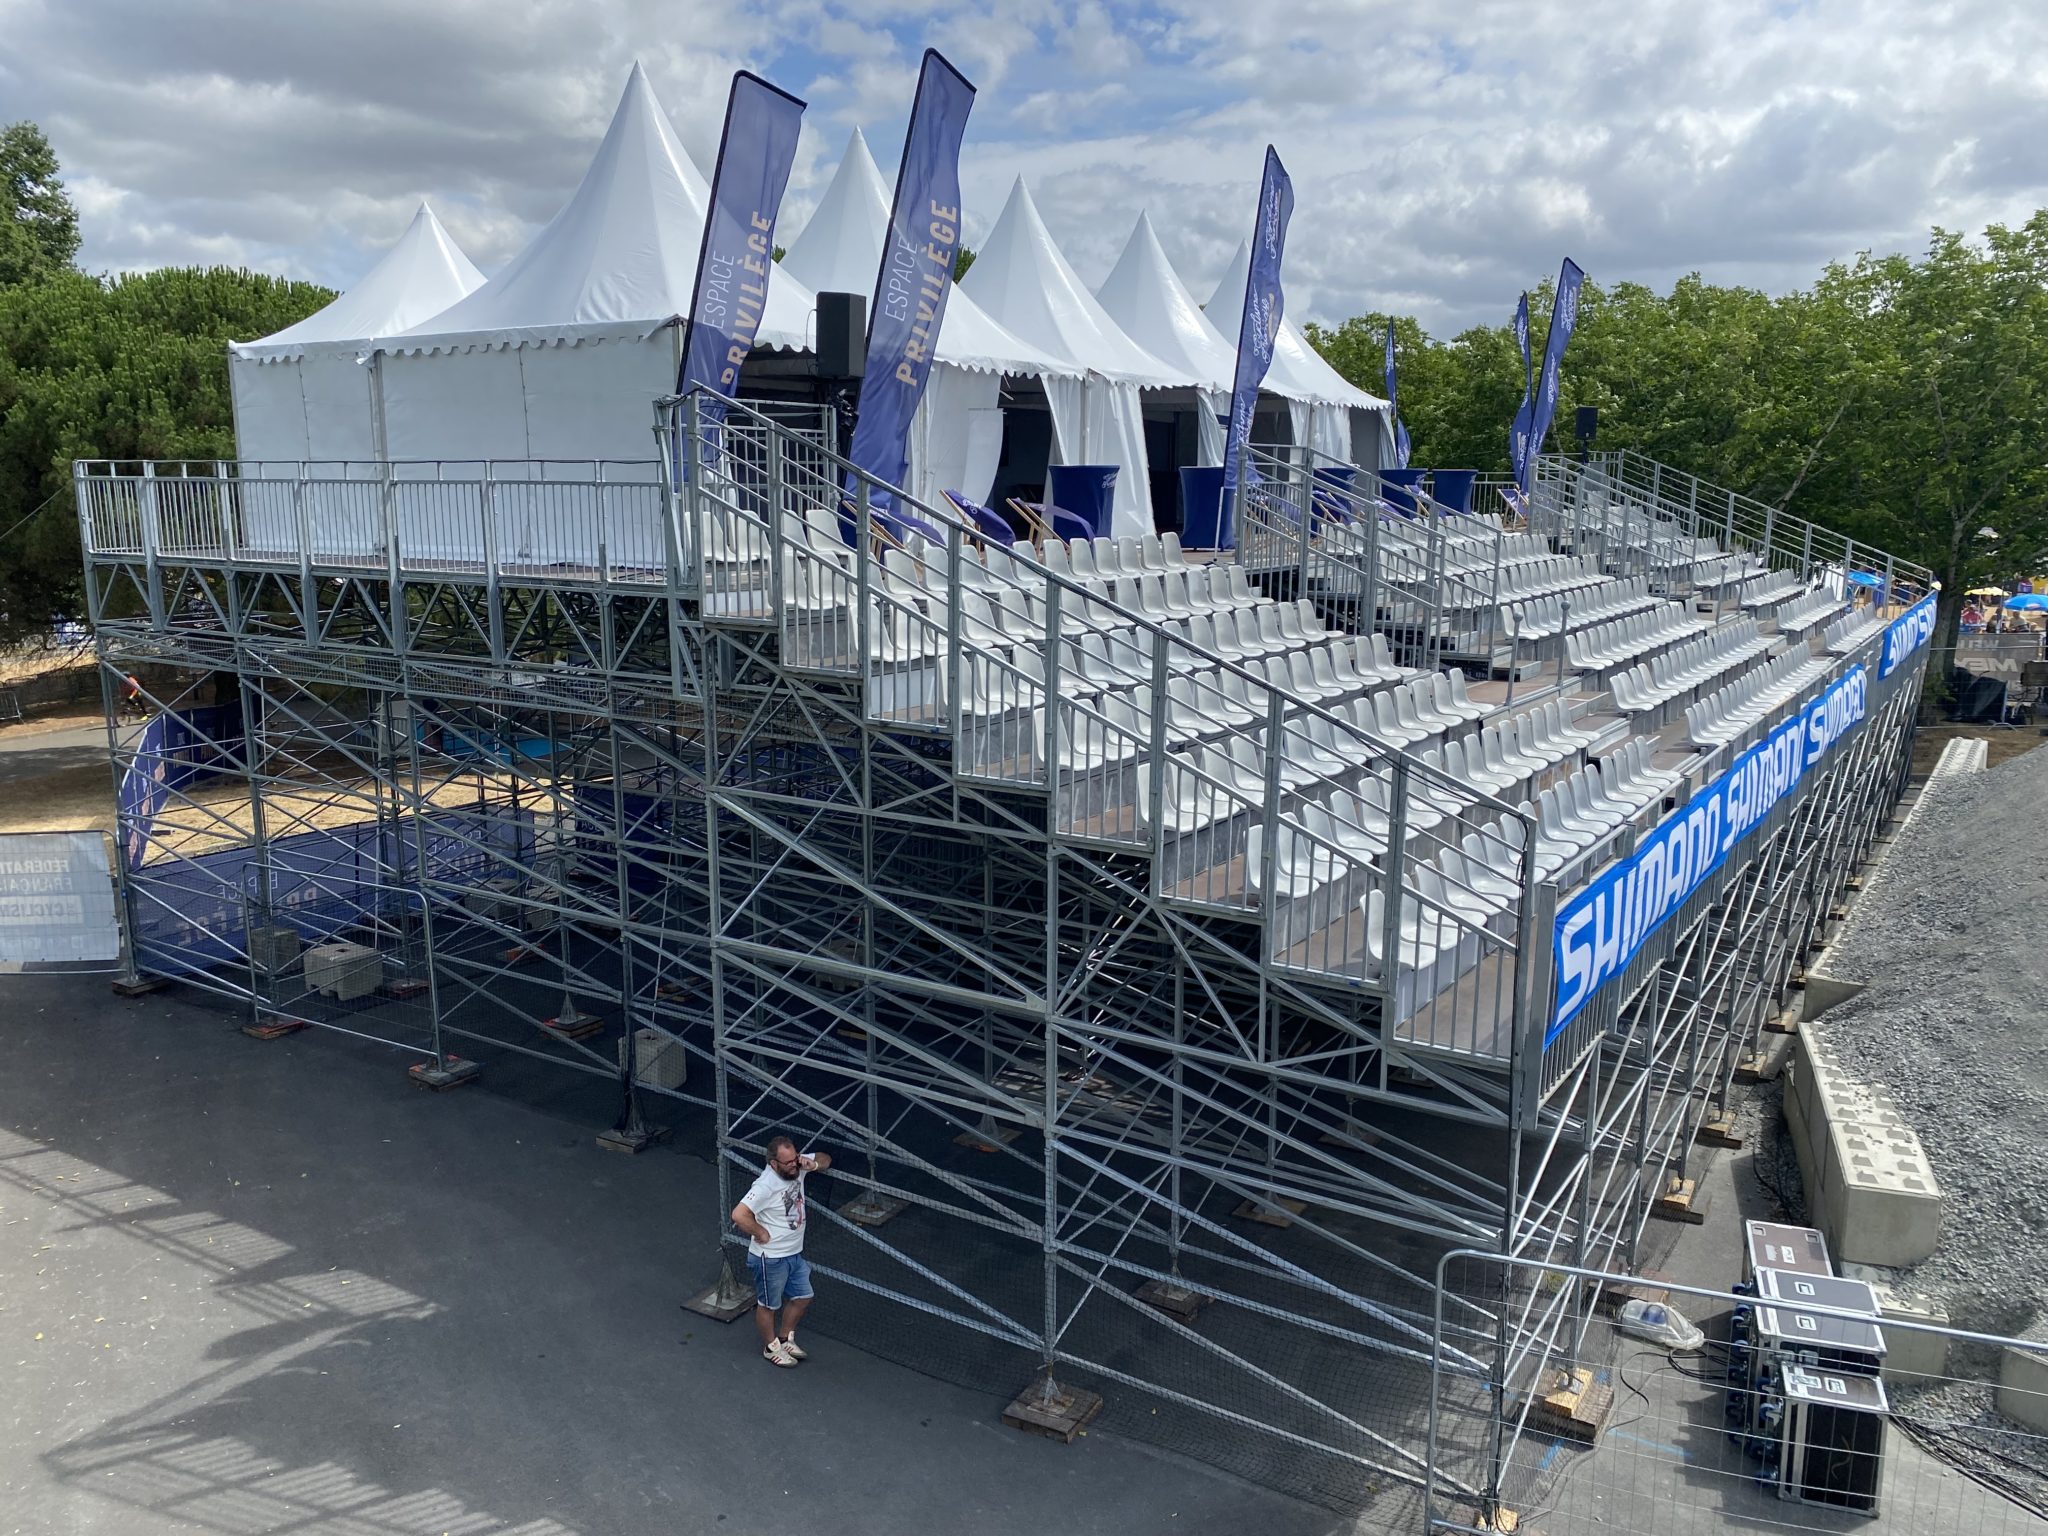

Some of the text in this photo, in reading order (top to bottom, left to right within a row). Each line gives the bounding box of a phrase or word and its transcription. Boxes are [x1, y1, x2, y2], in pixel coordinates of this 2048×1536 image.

[702, 250, 735, 330] ESPACE
[884, 236, 919, 323] ESPACE
[895, 199, 958, 388] PRIVILÈGE
[1553, 793, 1721, 1030] SHIMANO
